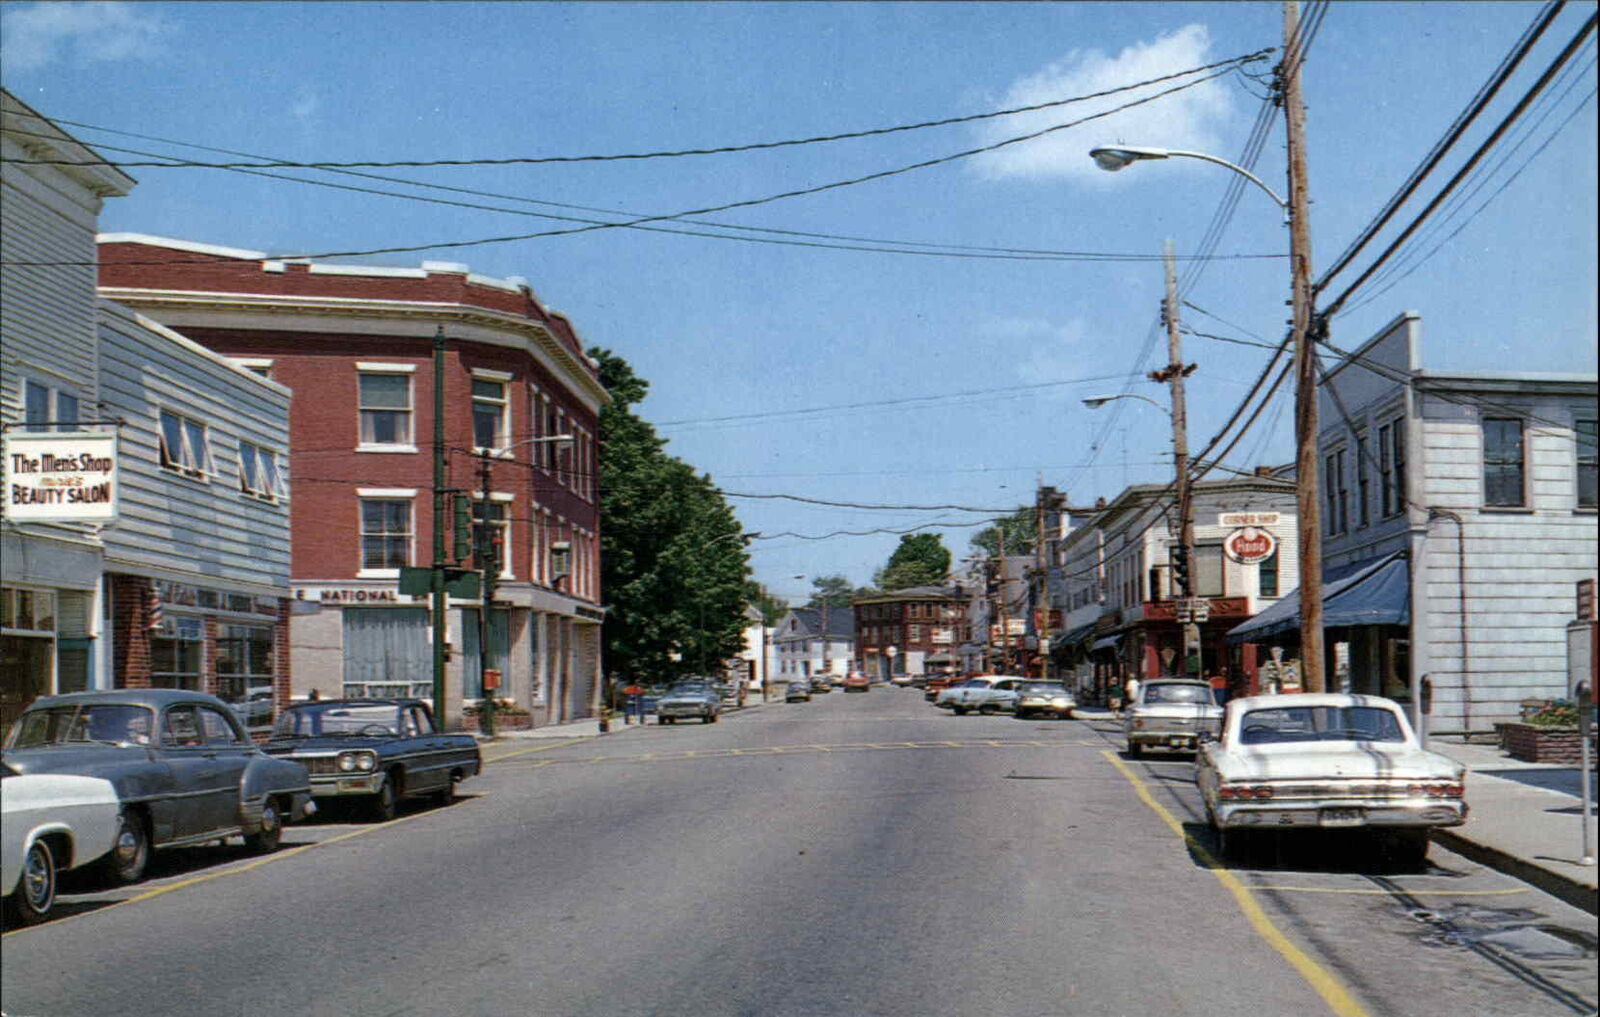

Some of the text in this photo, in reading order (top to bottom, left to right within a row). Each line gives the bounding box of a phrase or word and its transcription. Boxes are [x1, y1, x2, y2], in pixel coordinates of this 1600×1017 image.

[11, 452, 113, 475] The Men's Shop
[12, 484, 64, 504] BEAUTY
[67, 481, 111, 503] SALON
[320, 589, 398, 601] NATIONAL
